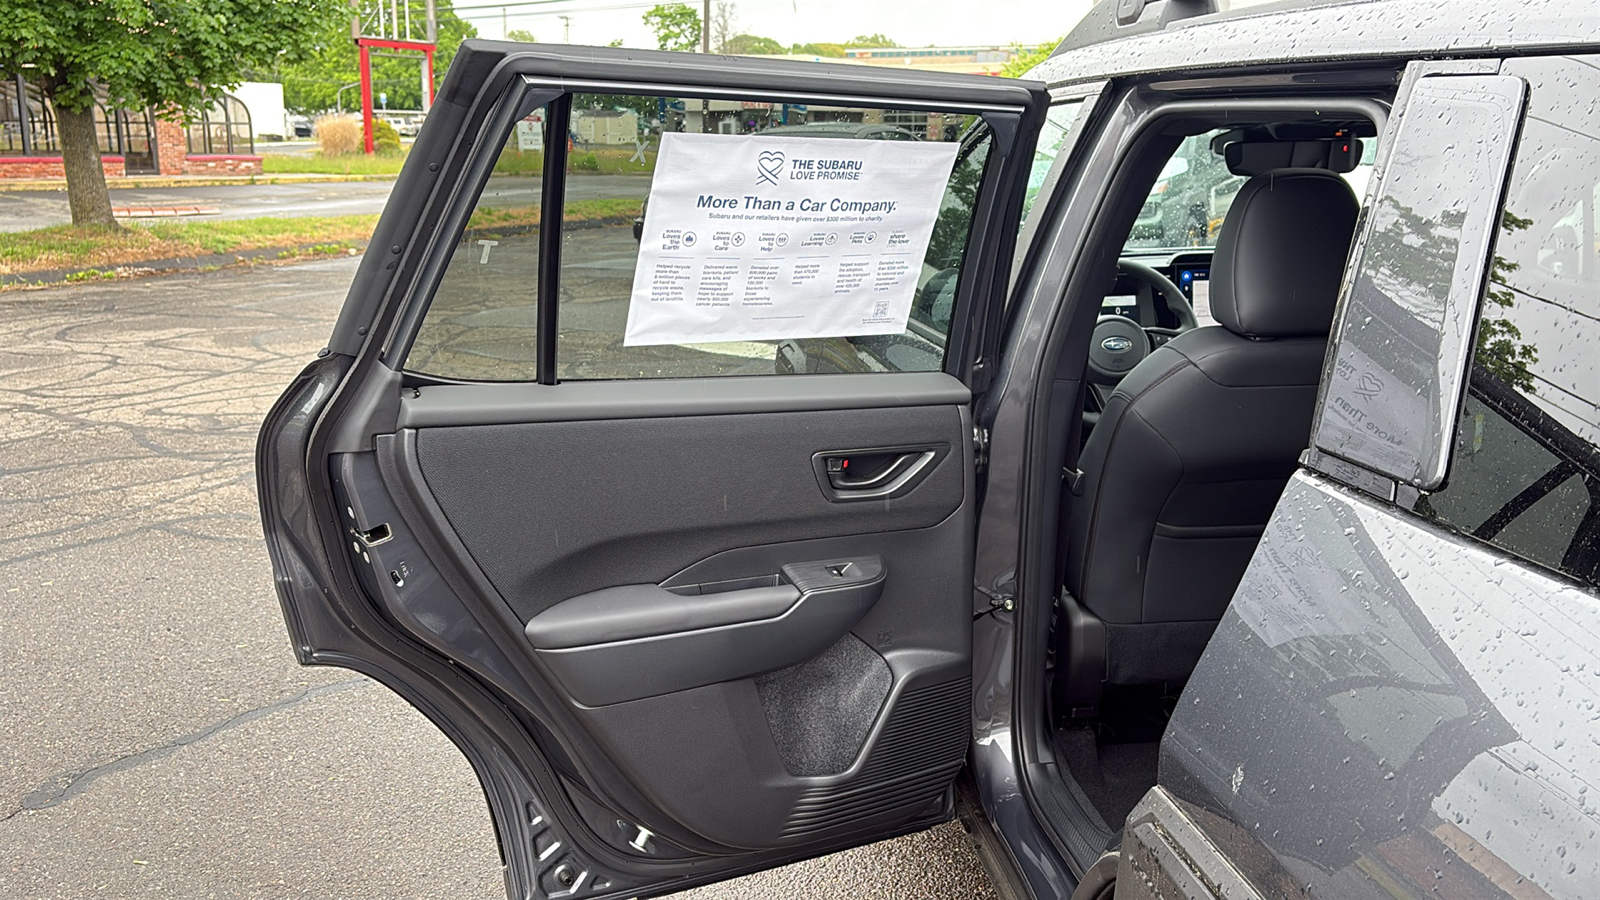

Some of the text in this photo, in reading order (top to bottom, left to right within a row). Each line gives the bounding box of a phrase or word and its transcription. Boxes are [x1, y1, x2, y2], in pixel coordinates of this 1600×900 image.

[792, 159, 863, 171] THE SUBARU
[790, 171, 815, 180] LOVE
[696, 195, 738, 209] More
[744, 196, 782, 211] Than
[785, 201, 795, 211] a
[799, 198, 826, 212] Car
[709, 212, 731, 220] Subaru
